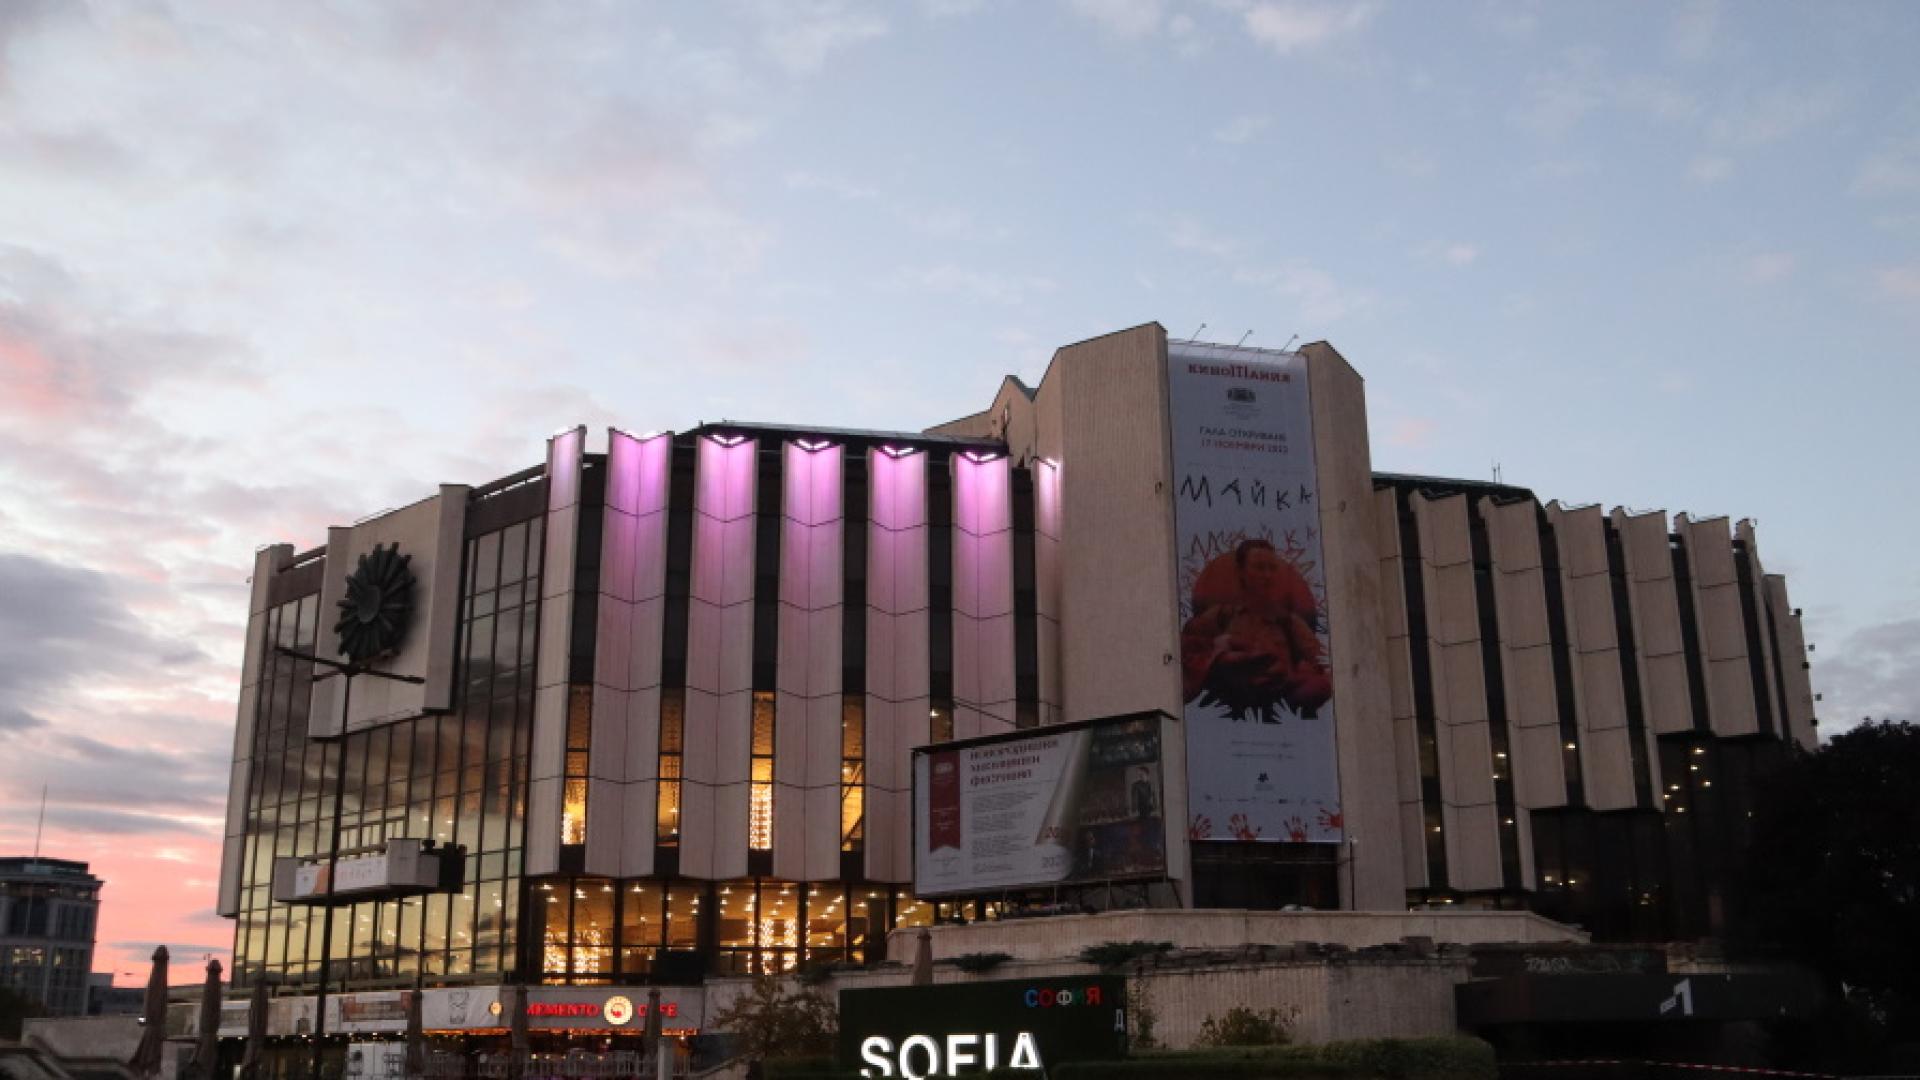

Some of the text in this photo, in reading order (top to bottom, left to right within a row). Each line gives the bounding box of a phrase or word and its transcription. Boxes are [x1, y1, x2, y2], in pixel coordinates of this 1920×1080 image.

[1180, 474, 1313, 510] МАЙКА
[1024, 985, 1103, 1008] СОФИЯ
[860, 1032, 1043, 1080] SOFIA
